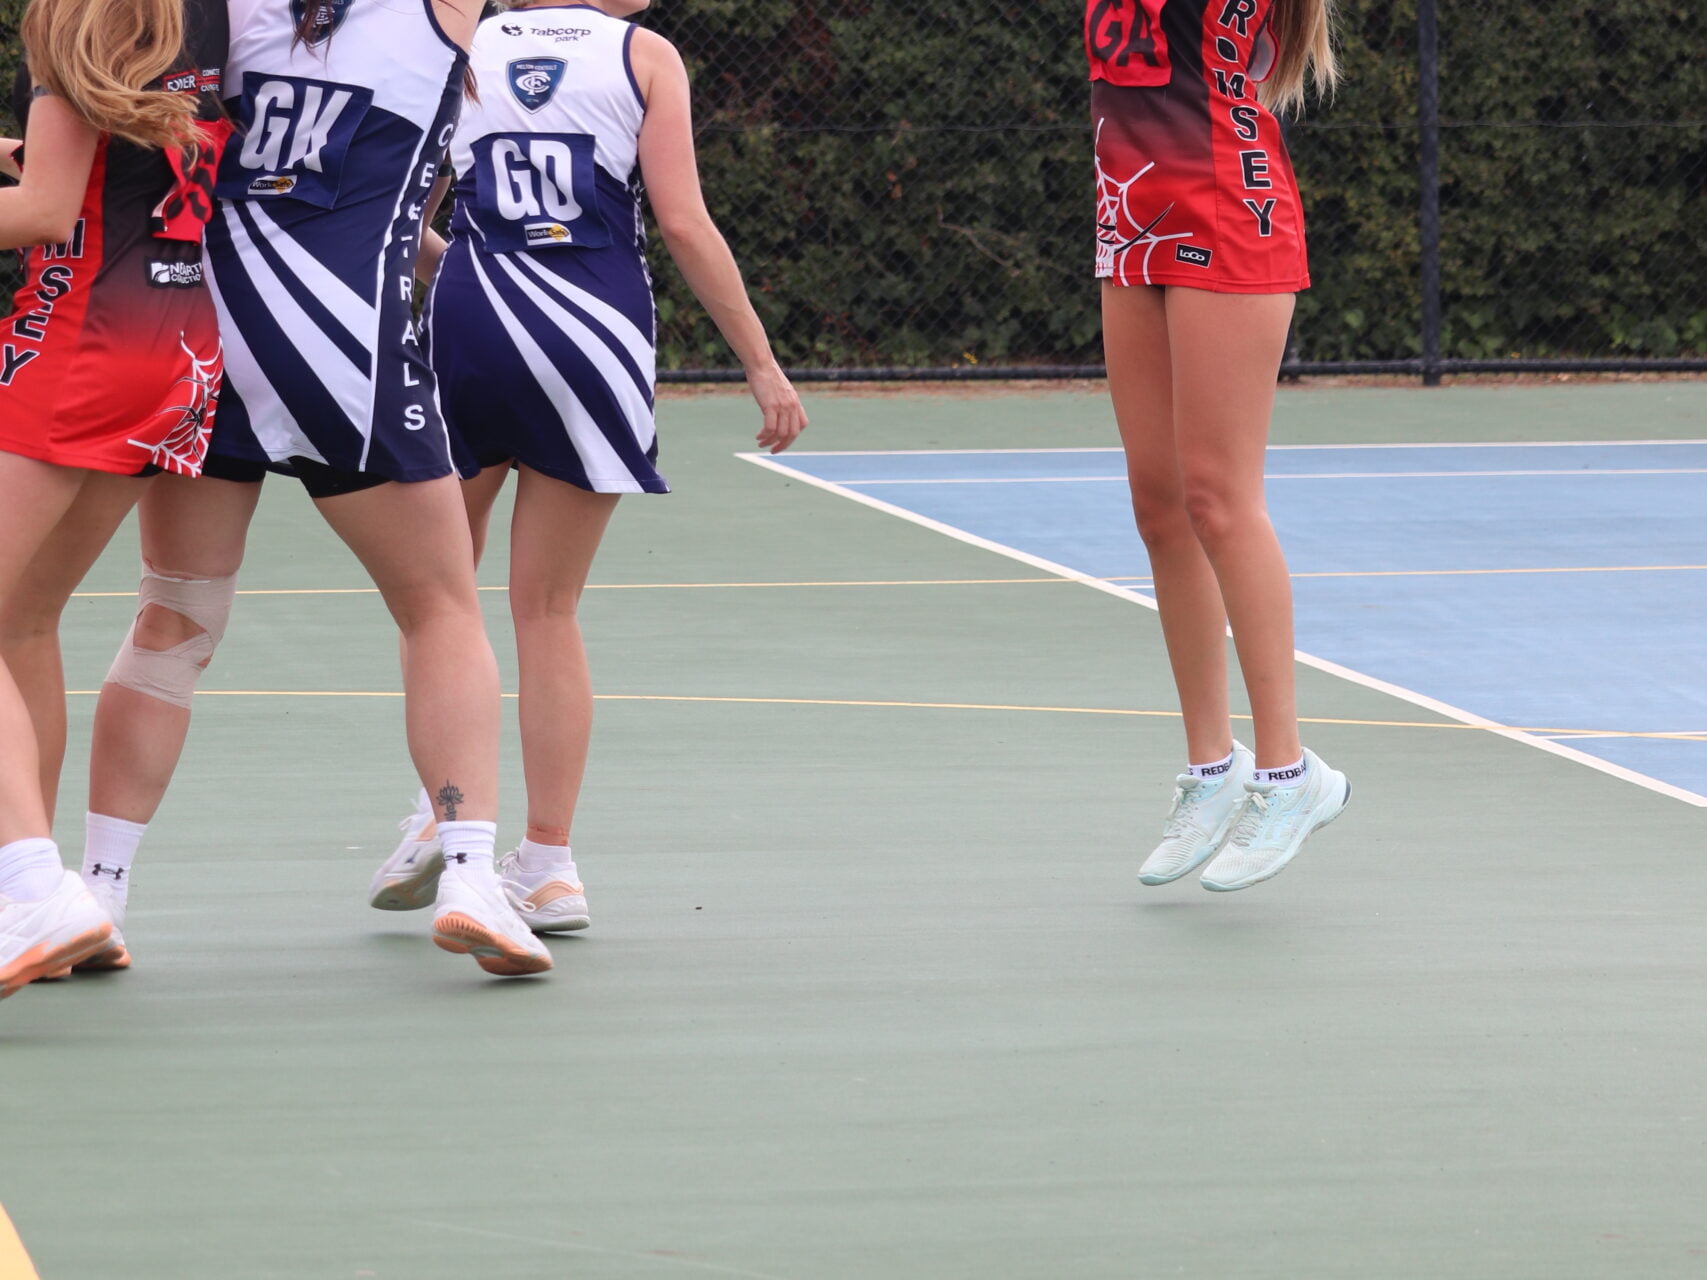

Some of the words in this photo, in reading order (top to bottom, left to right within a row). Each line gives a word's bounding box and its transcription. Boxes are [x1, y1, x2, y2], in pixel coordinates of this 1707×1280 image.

[530, 27, 592, 37] Tabcorp
[555, 35, 579, 43] park
[239, 80, 354, 173] GK
[491, 138, 583, 222] GD
